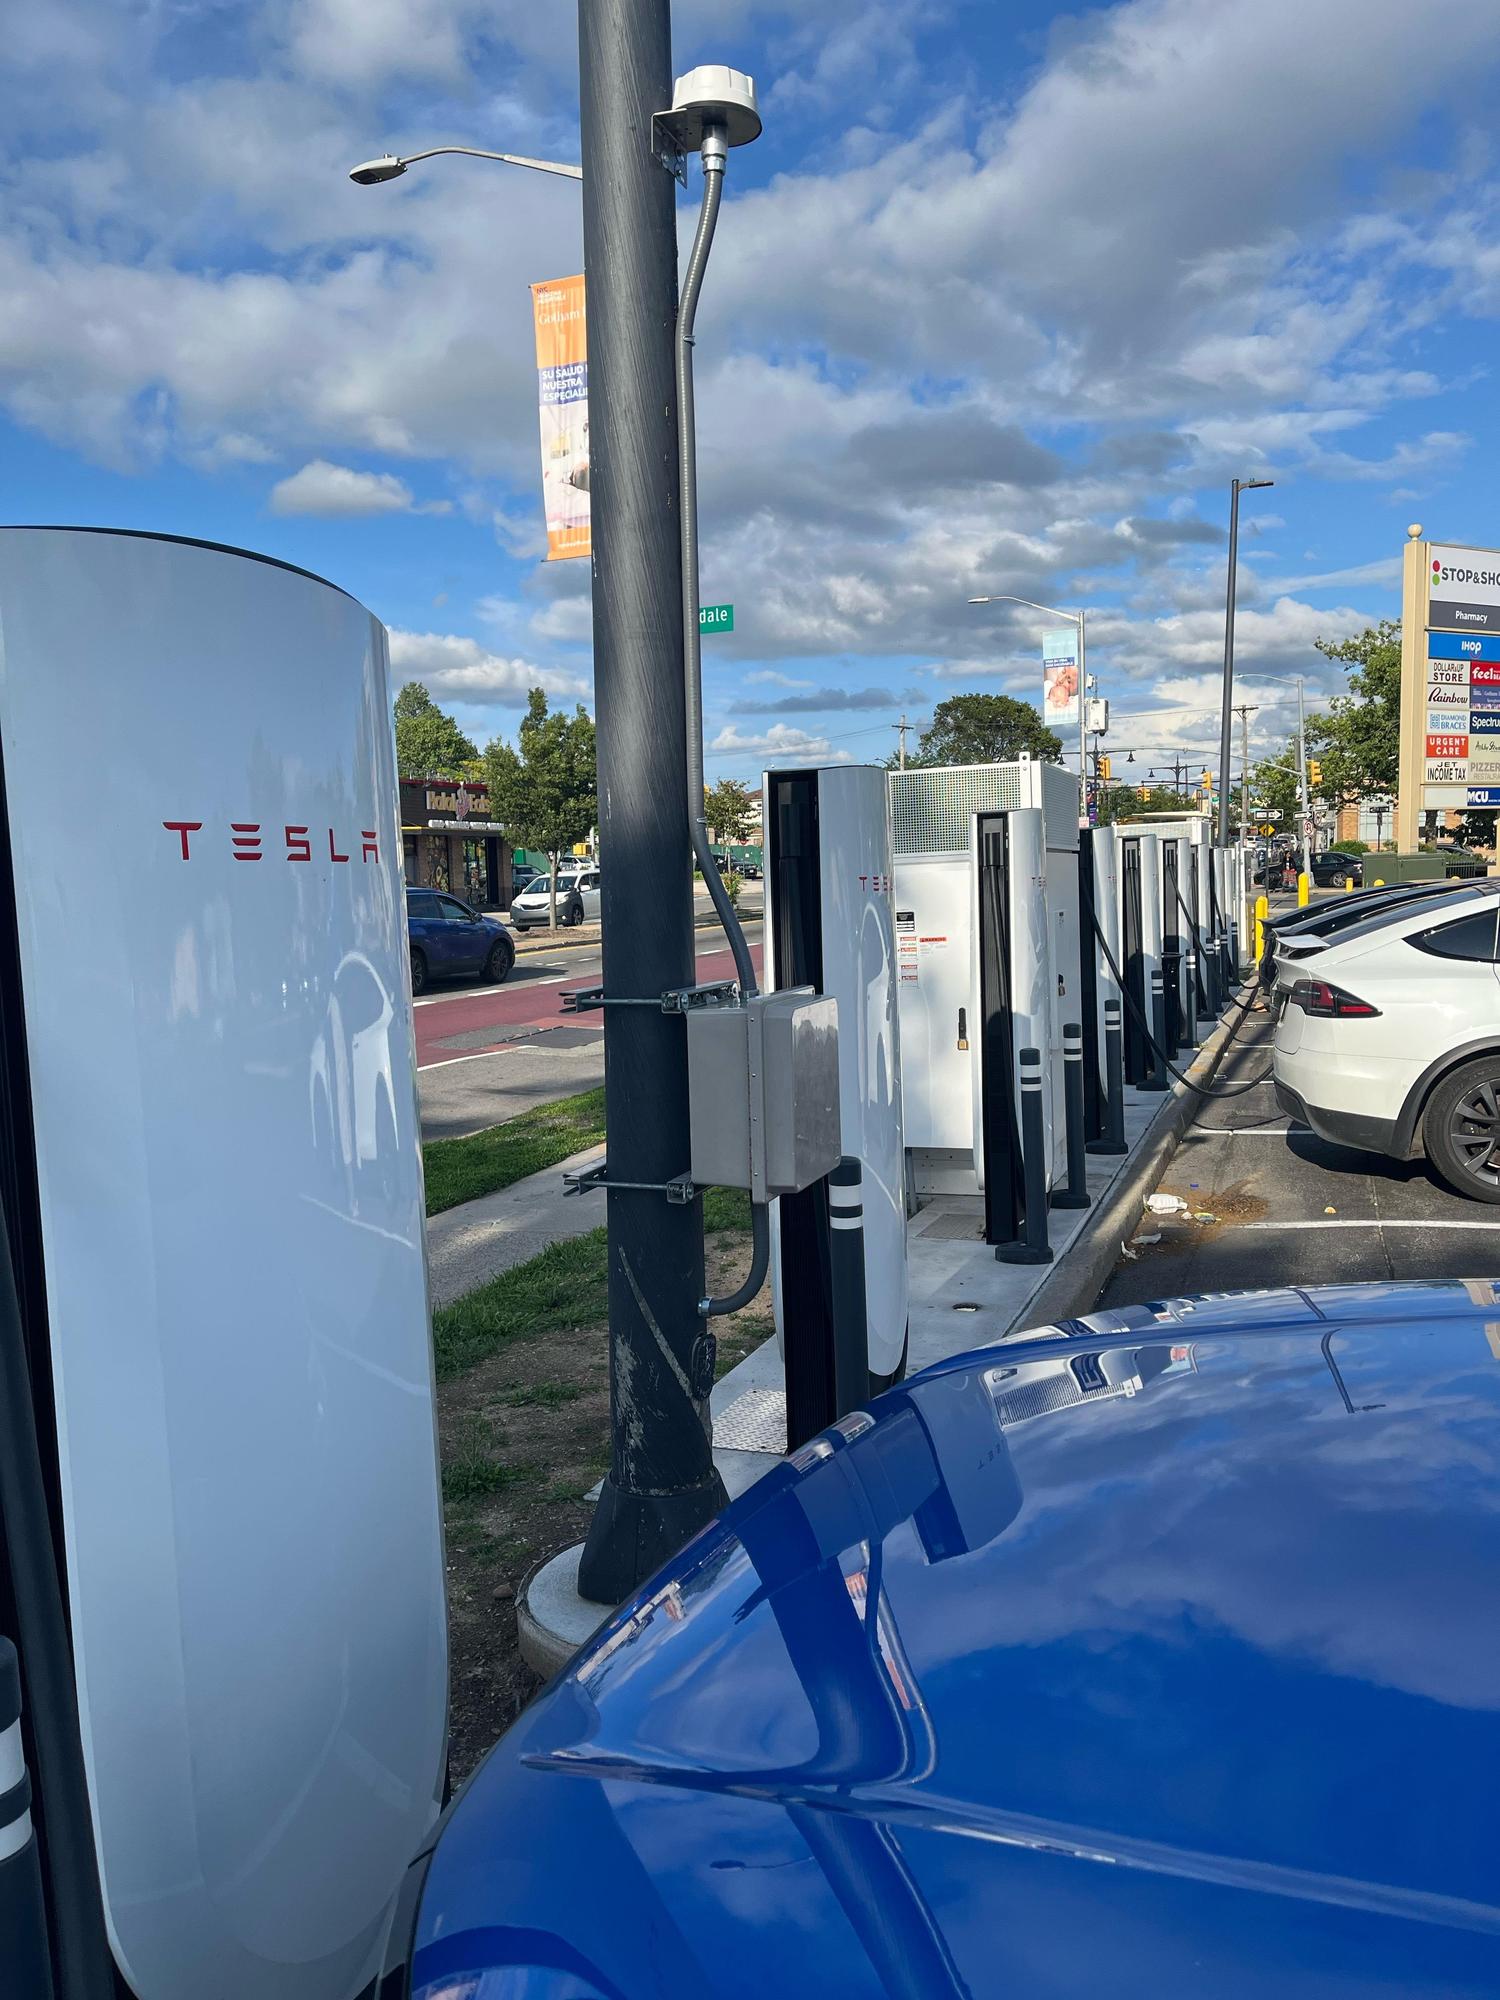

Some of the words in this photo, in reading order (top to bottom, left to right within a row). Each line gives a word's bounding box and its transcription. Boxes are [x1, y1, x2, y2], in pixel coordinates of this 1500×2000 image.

[542, 370, 554, 379] SU
[556, 365, 584, 378] SALUD
[542, 377, 583, 390] NUESTRA
[699, 607, 728, 624] dale
[1455, 610, 1488, 624] Pharmacy
[1433, 672, 1463, 682] STORE
[1472, 667, 1493, 680] feel
[1428, 687, 1468, 703] Rainbow
[1441, 721, 1466, 730] BRACES
[1430, 737, 1466, 746] URGENT
[1436, 747, 1460, 755] CARE
[1427, 767, 1453, 780] INCOME
[1455, 768, 1466, 780] TAX
[1467, 791, 1489, 803] MCU
[162, 821, 379, 864] TESLA
